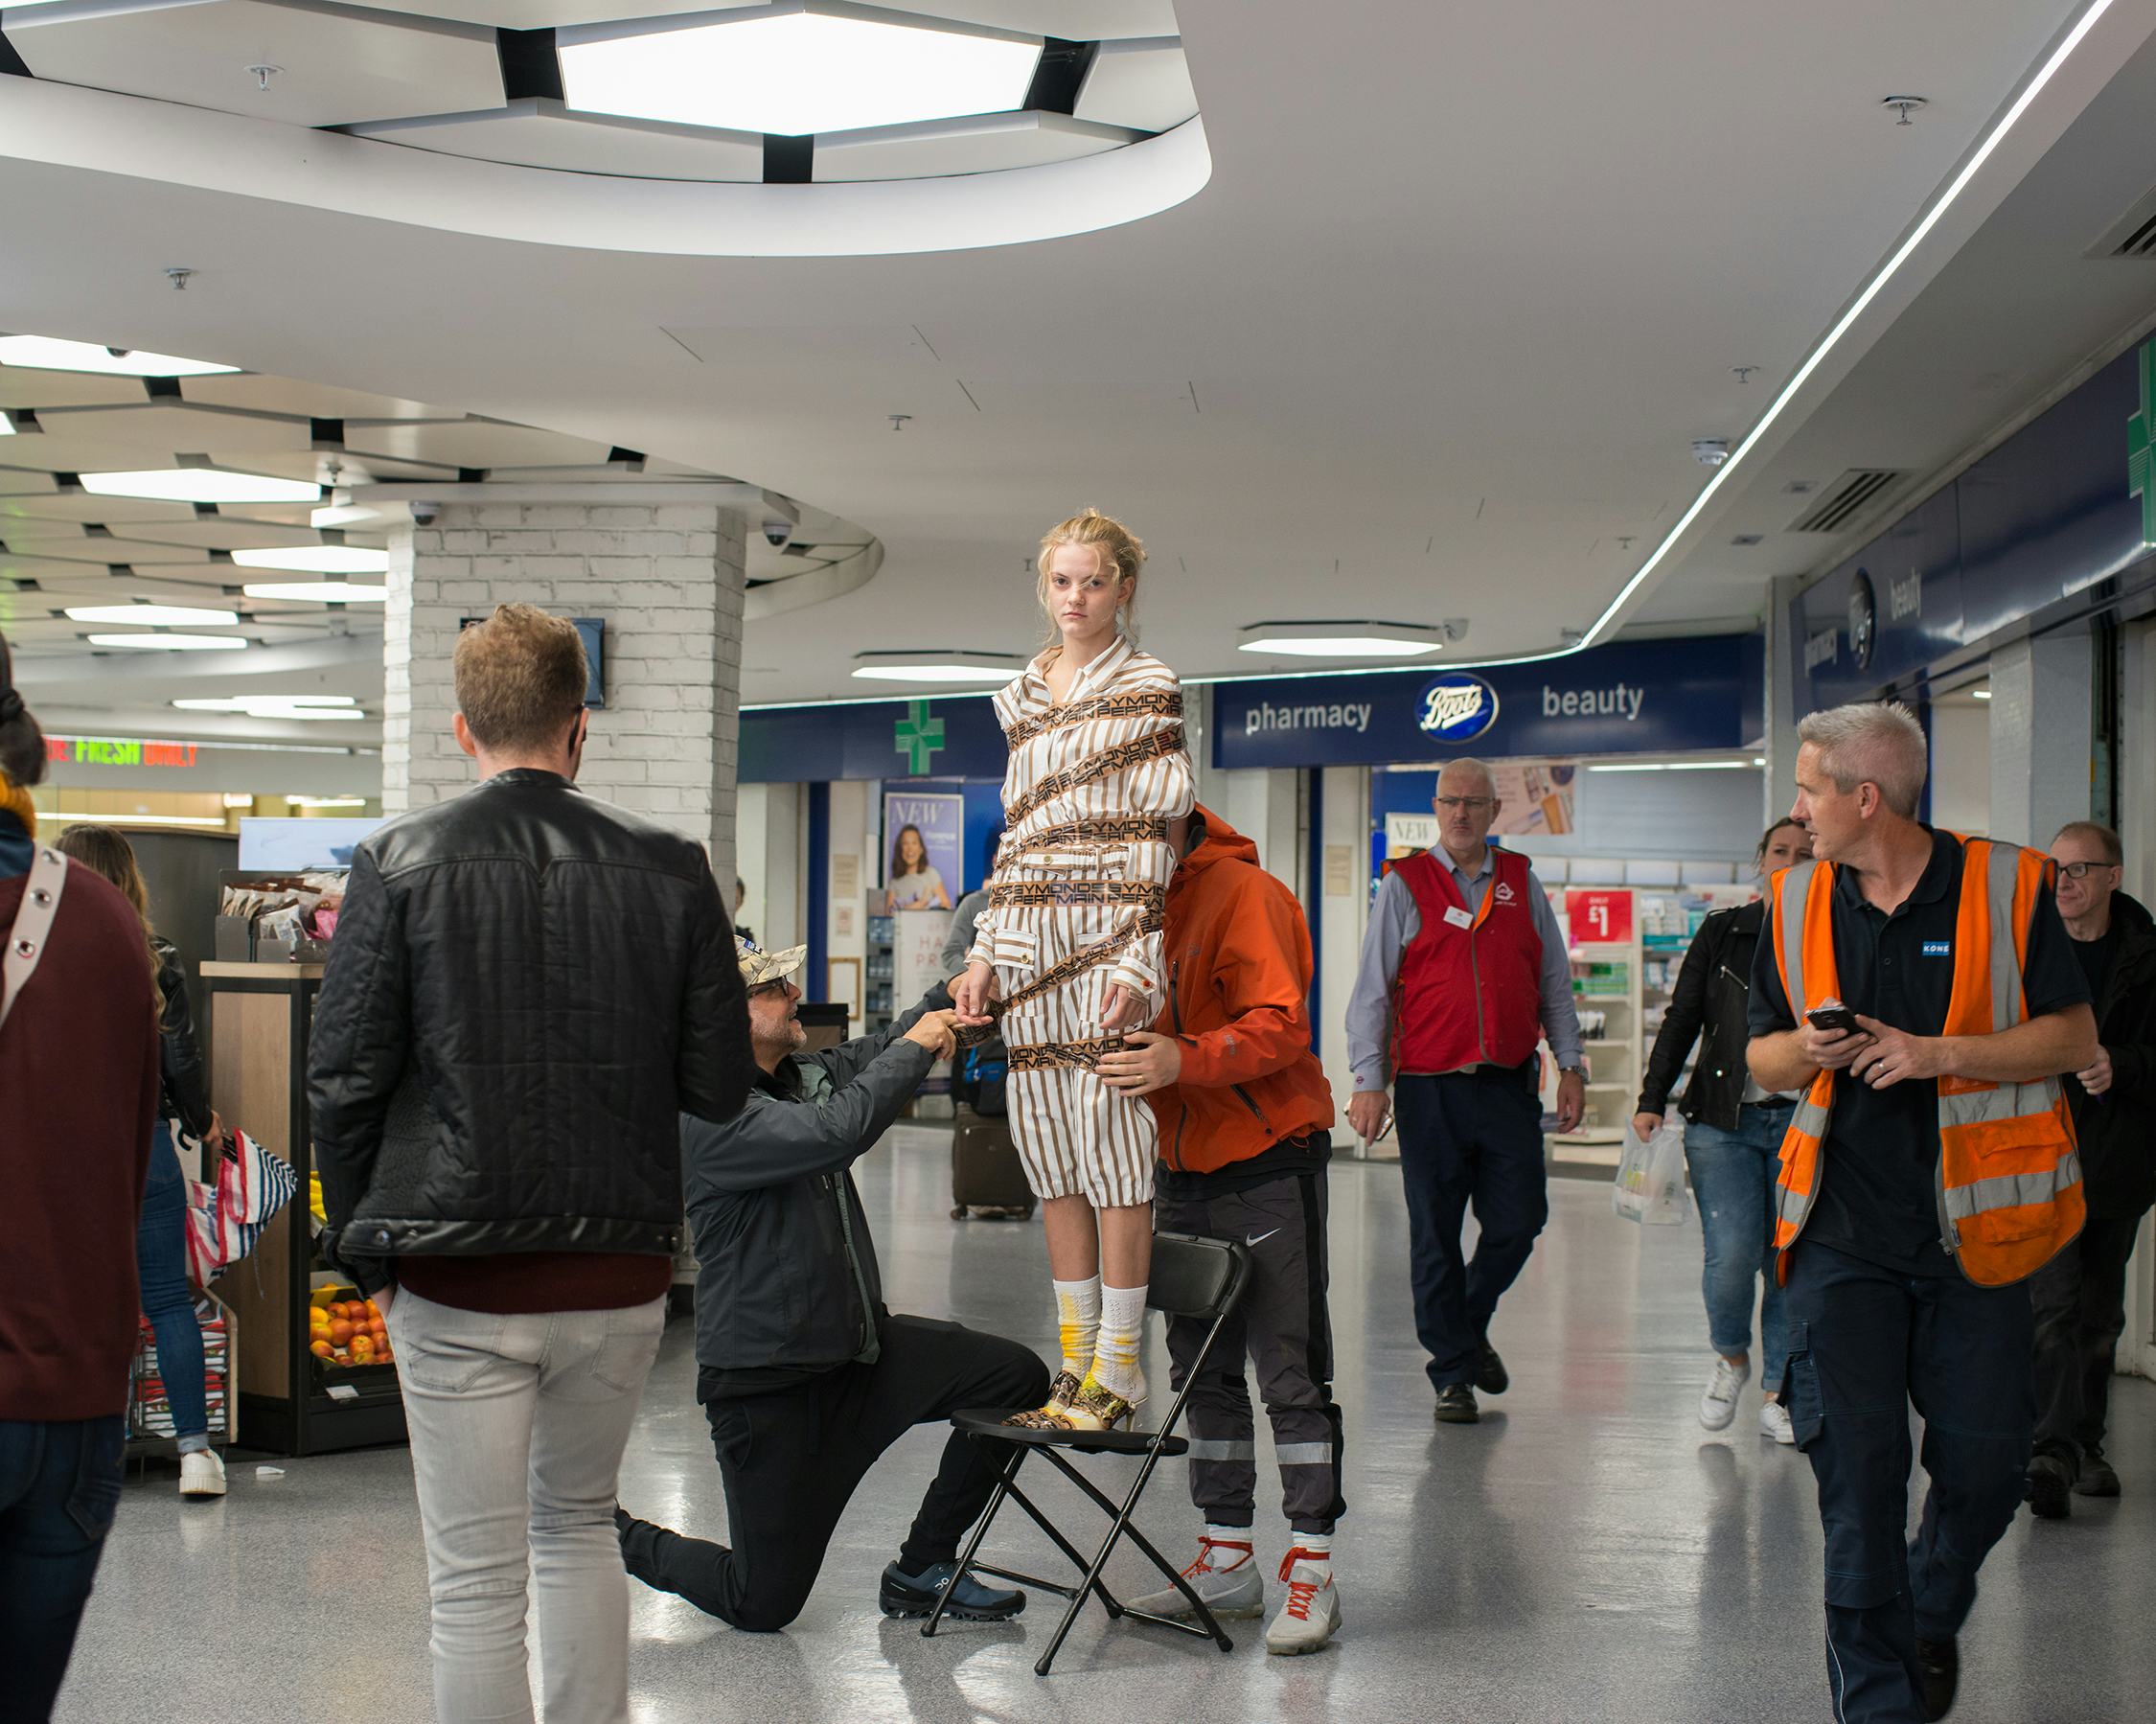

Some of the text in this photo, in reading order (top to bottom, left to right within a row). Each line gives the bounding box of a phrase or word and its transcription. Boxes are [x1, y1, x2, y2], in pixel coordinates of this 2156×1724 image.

[1246, 682, 1644, 736] pharmacy Boots beauty
[75, 737, 140, 766] FRESH
[891, 801, 943, 824] NEW
[1392, 821, 1433, 839] NEW
[1014, 883, 1105, 895] SYMONDS
[1588, 905, 1609, 937] £1
